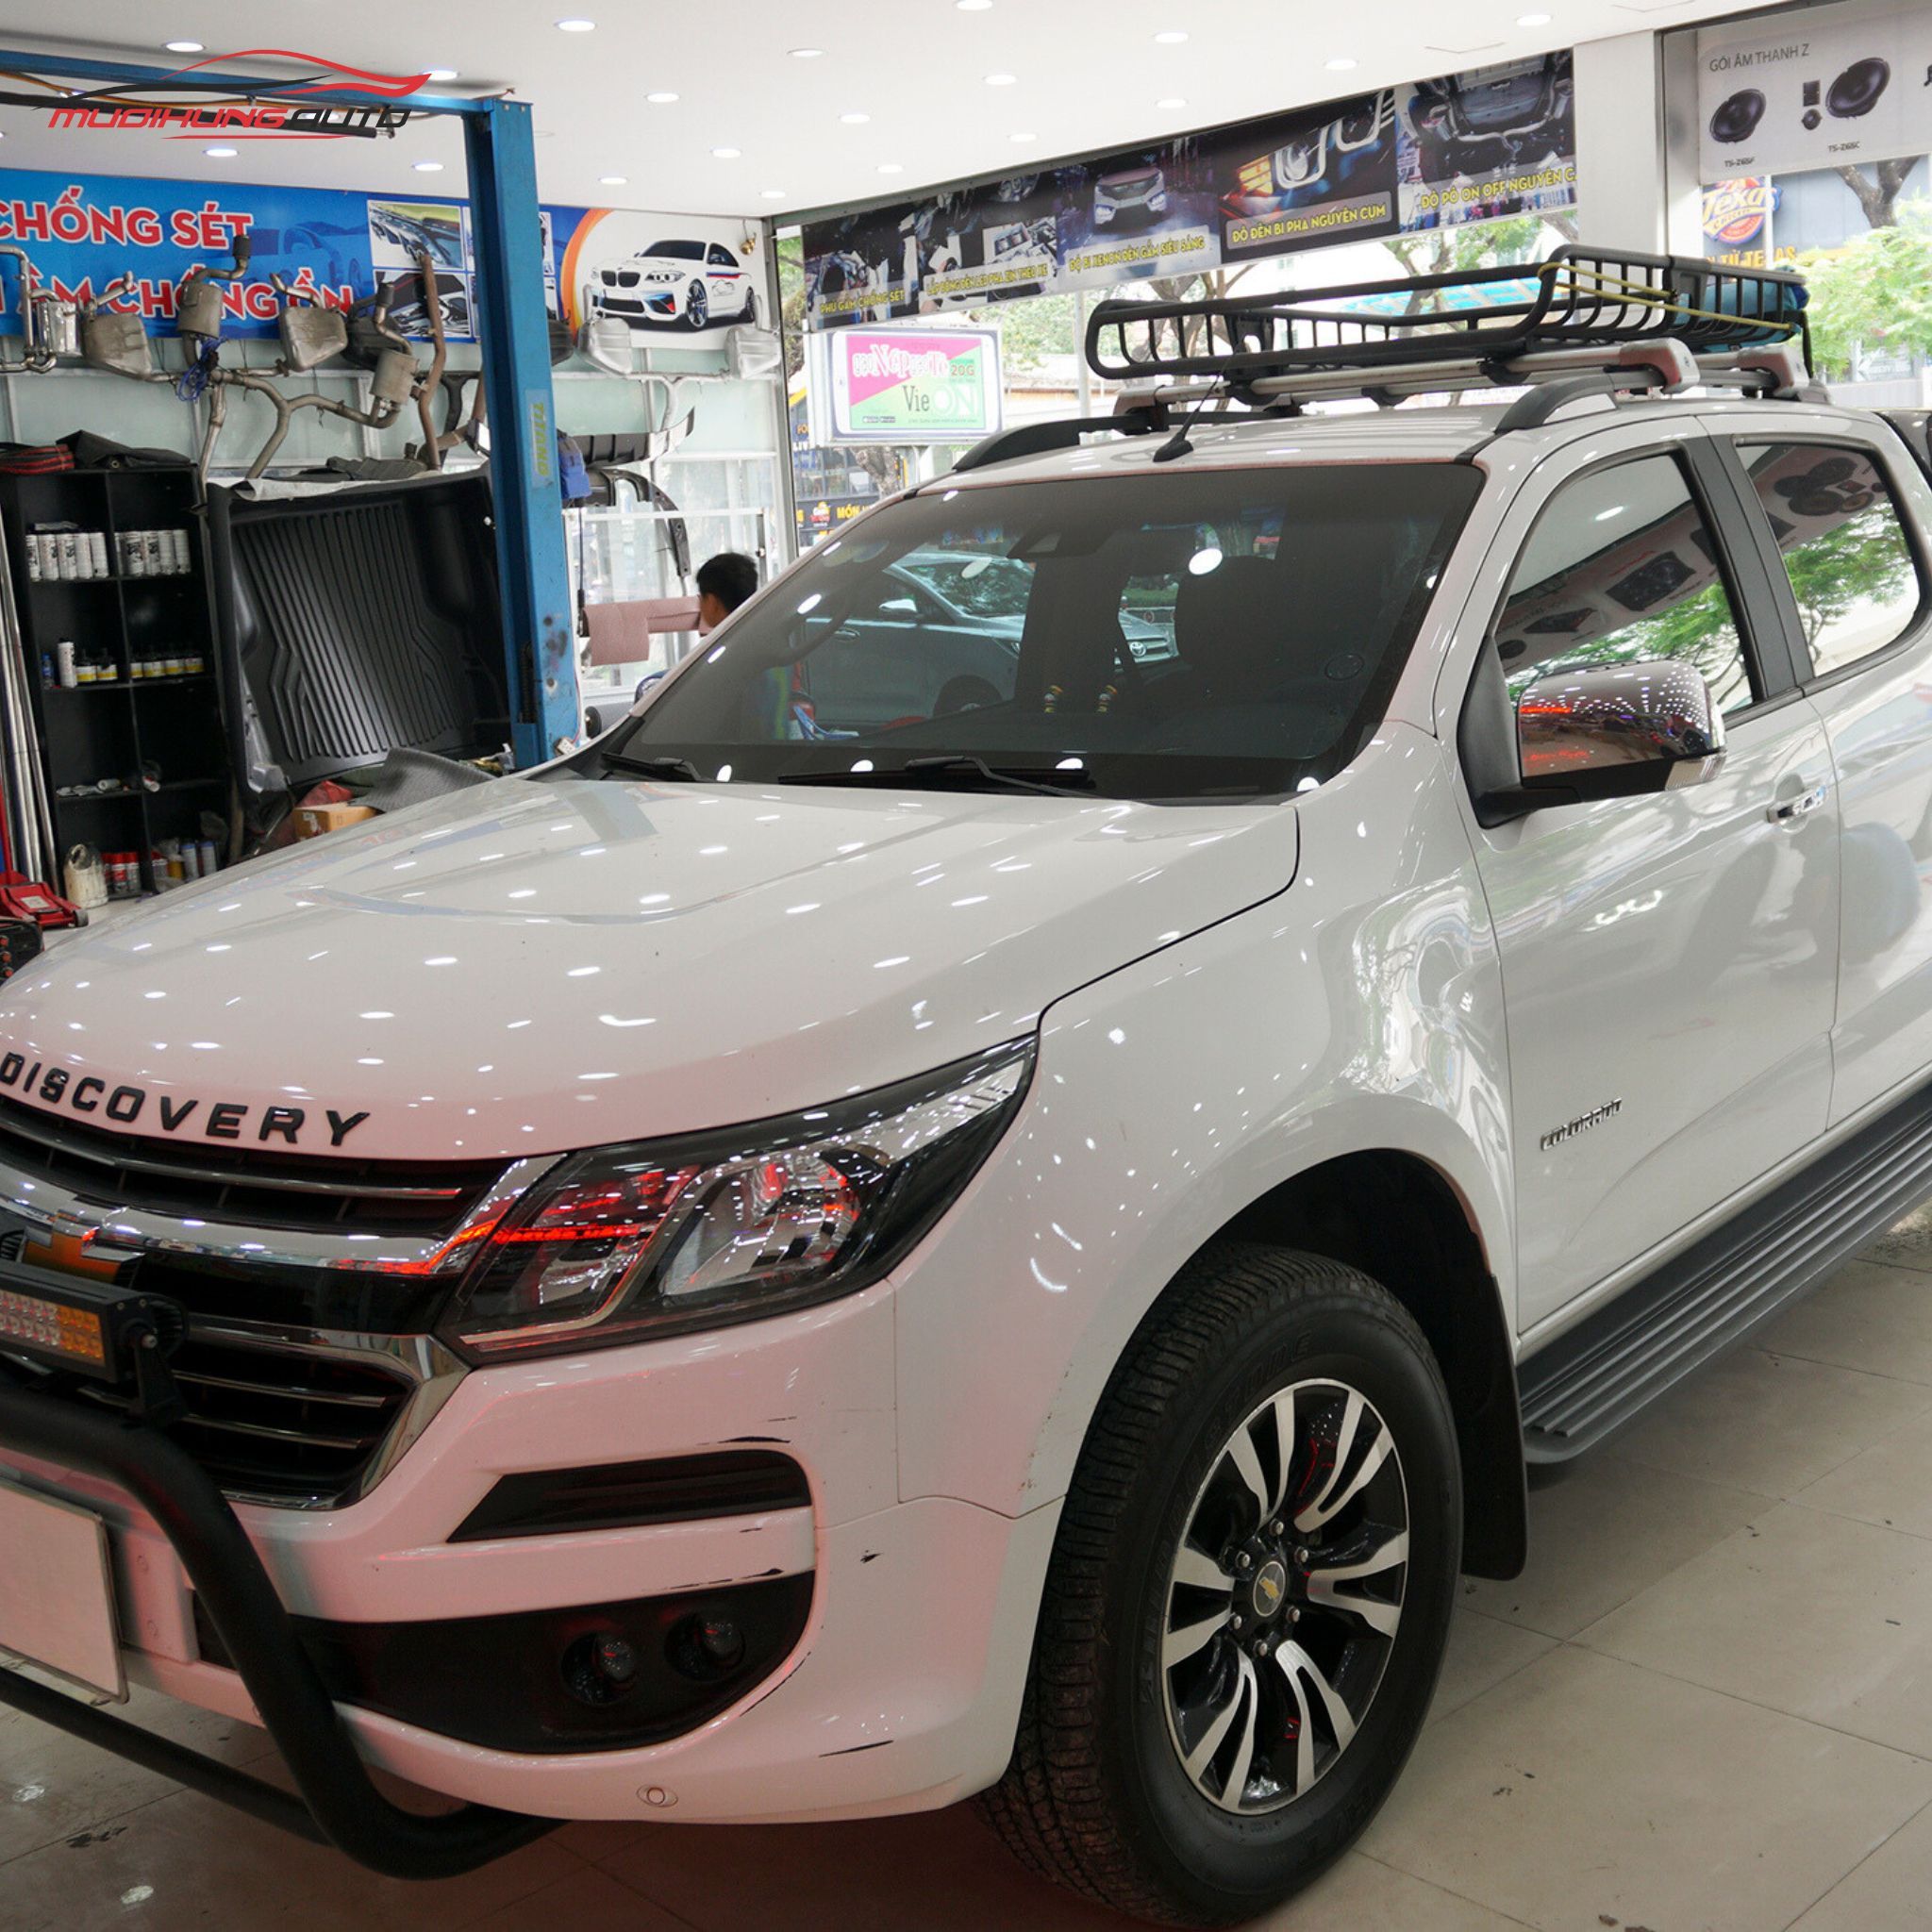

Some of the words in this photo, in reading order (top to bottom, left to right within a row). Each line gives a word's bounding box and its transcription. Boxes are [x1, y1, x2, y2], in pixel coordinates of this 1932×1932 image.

[1755, 44, 1799, 65] THANH
[1802, 42, 1810, 57] Z
[1461, 185, 1481, 202] ON
[1482, 179, 1506, 198] OFF
[1508, 168, 1562, 192] NGUYÊN
[171, 201, 254, 250] SÉT
[1232, 225, 1249, 243] ĐỘ
[1250, 223, 1272, 240] ĐÈN
[1274, 221, 1285, 236] BI
[1287, 217, 1309, 233] PHA
[1310, 206, 1358, 229] NGUYÊN
[1359, 202, 1387, 223] CỤM
[1702, 186, 1778, 226] Texa
[106, 263, 280, 321] CHNG
[0, 1051, 371, 1148] DISCOVERY
